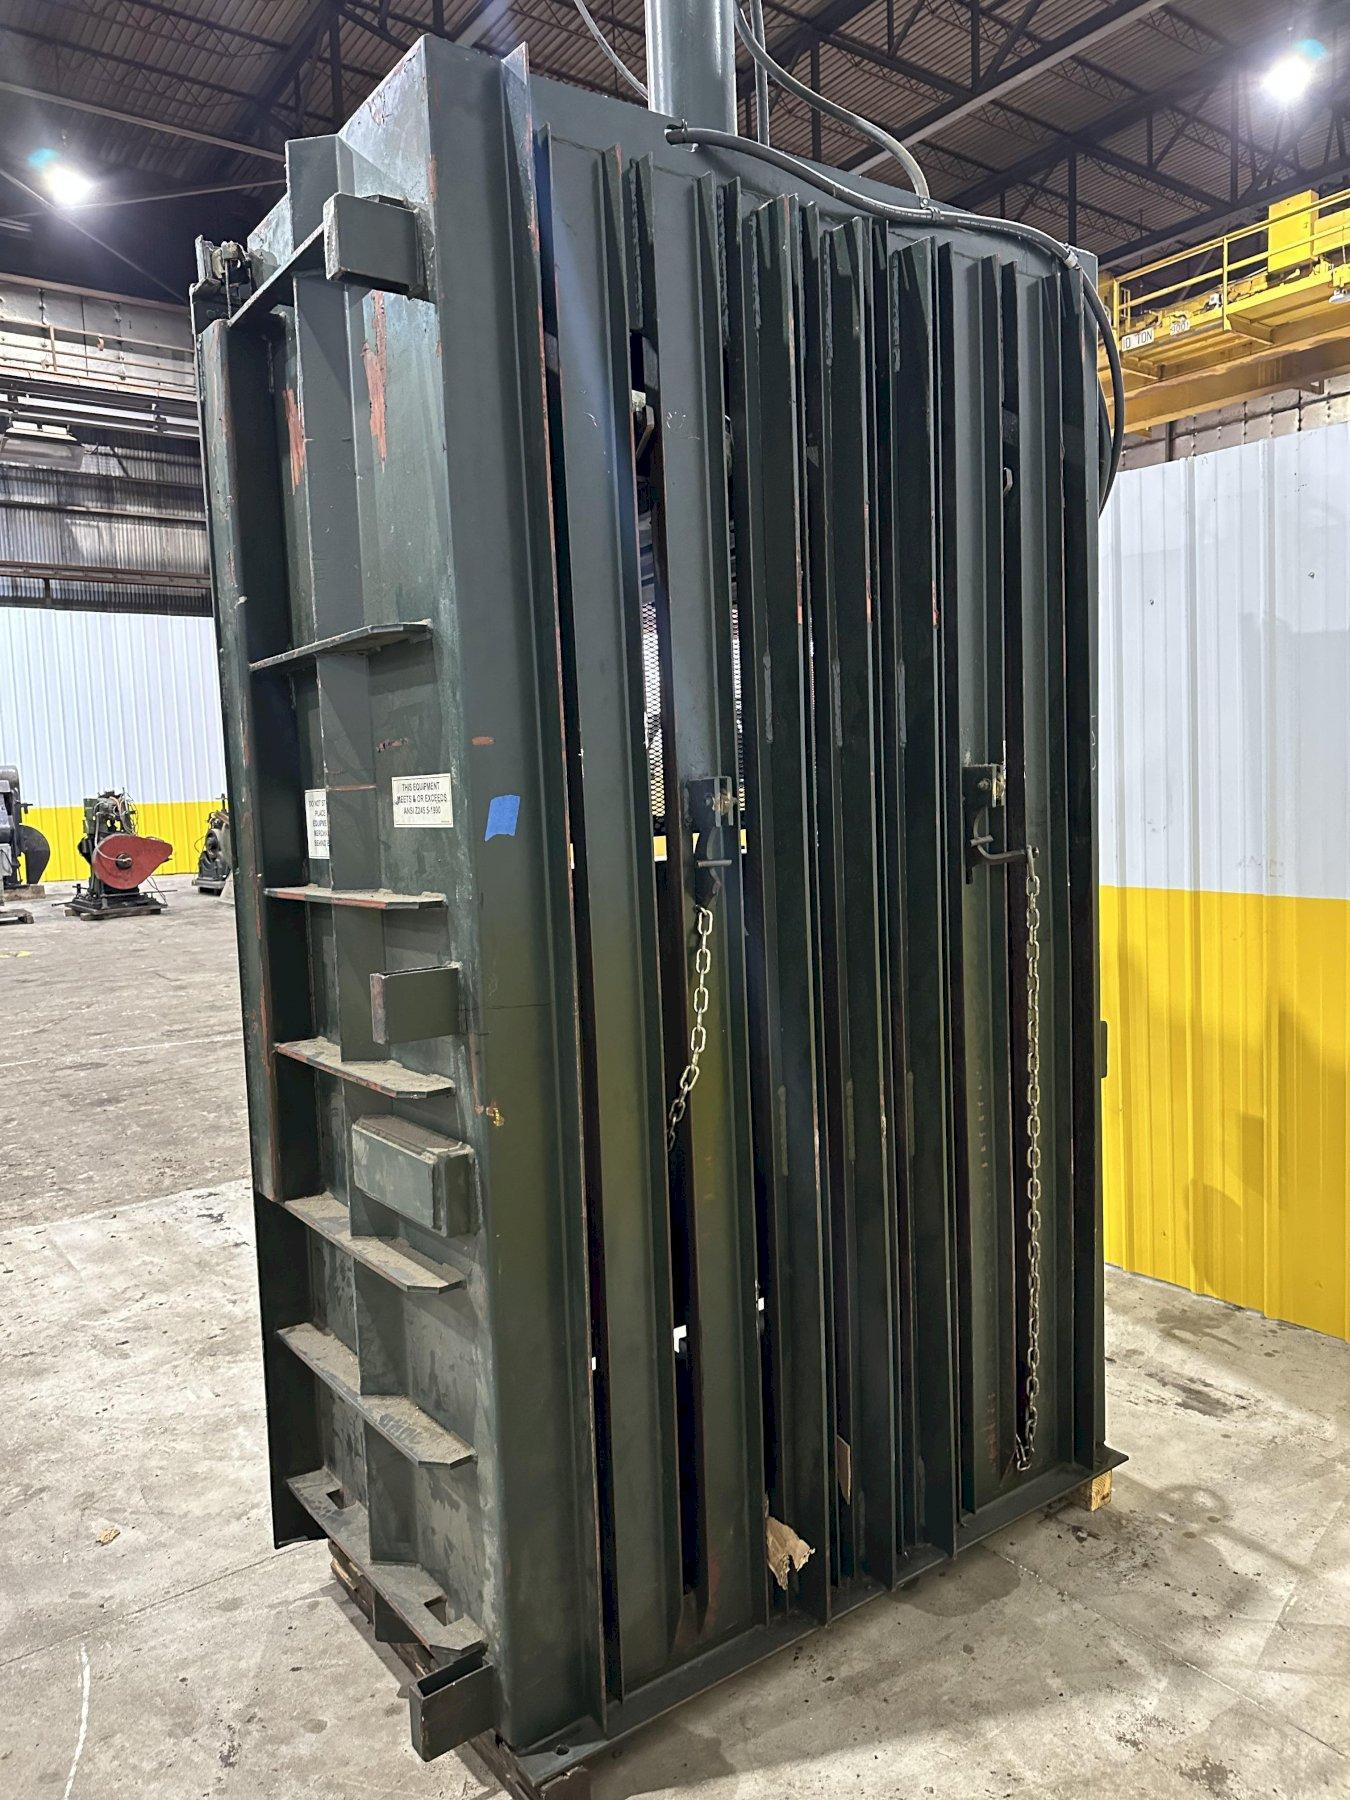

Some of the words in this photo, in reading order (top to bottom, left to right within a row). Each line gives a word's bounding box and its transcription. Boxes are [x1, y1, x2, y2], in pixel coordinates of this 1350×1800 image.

[1135, 330, 1153, 344] TON
[402, 783, 412, 791] THIS
[413, 781, 440, 791] EQUIPMENT
[417, 794, 424, 802] OR
[425, 793, 448, 803] EXCEEDS
